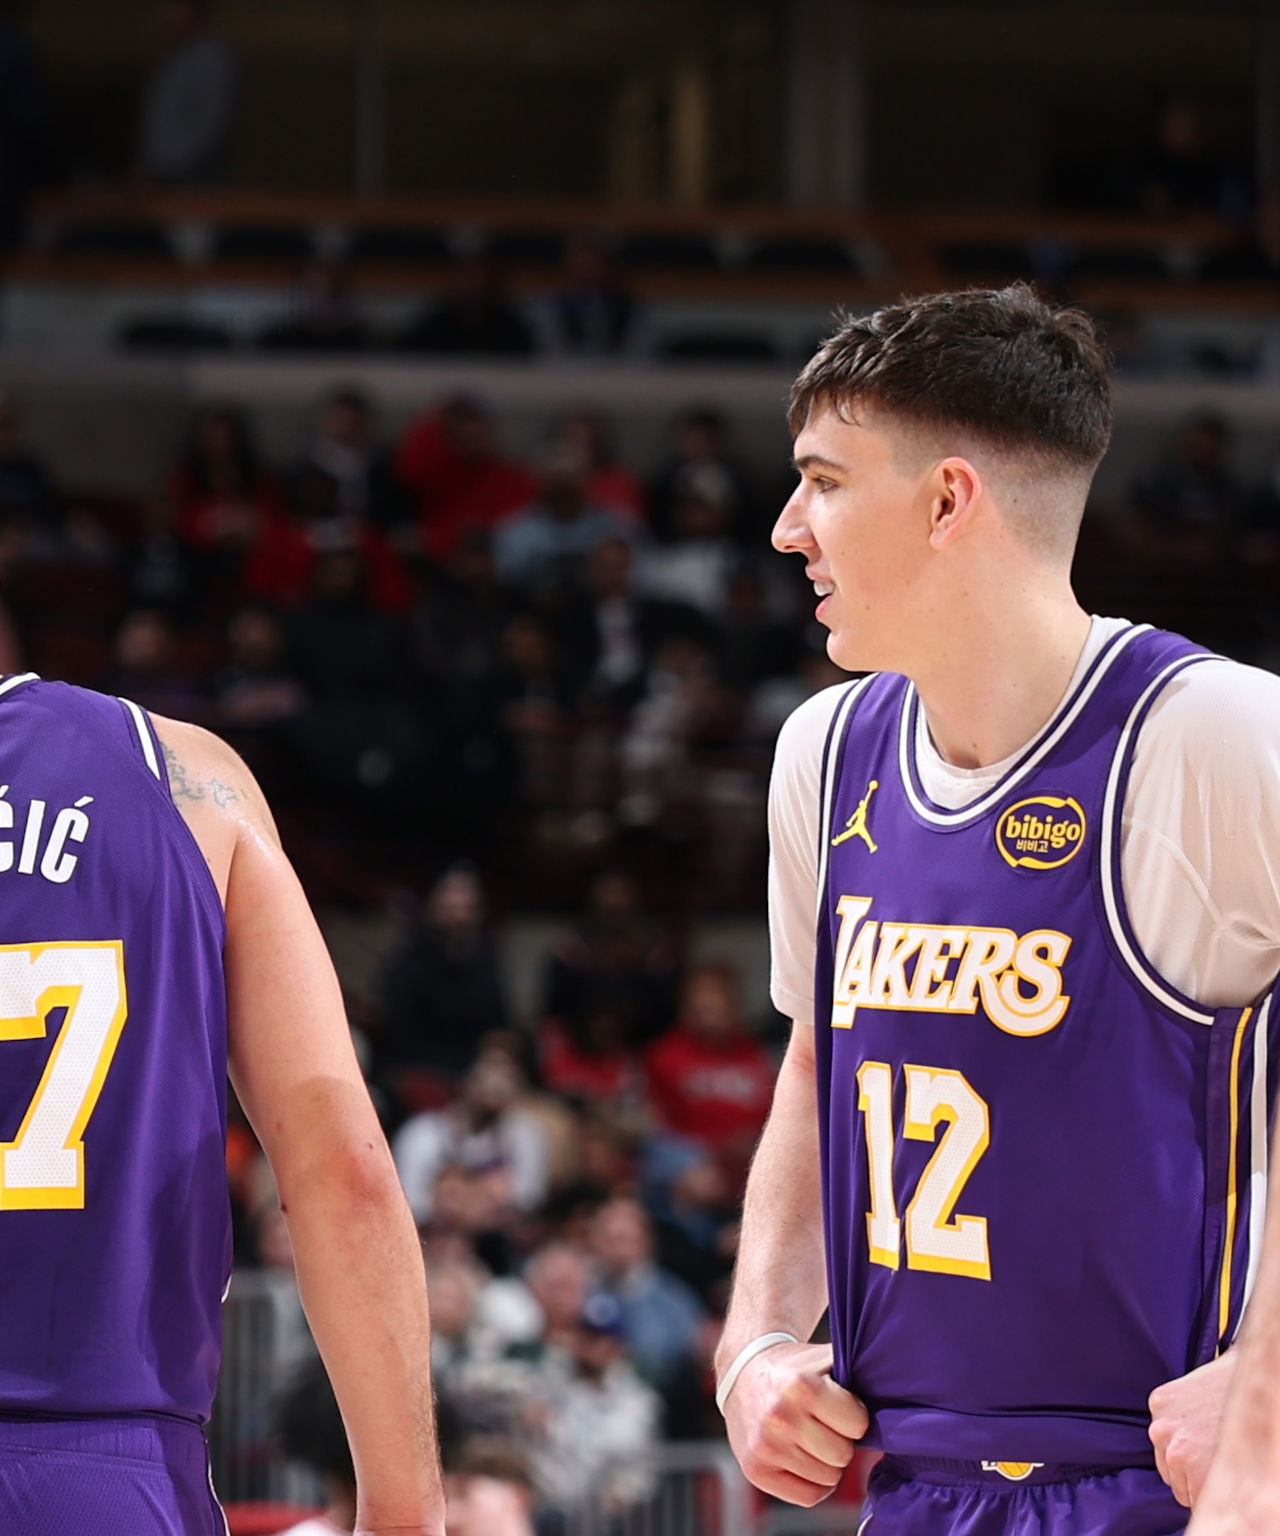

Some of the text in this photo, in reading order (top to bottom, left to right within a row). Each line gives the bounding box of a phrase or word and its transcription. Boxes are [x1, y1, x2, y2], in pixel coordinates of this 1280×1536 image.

[1005, 814, 1080, 848] bibigo
[831, 895, 1072, 1037] LAKERS
[856, 1061, 992, 1281] 12
